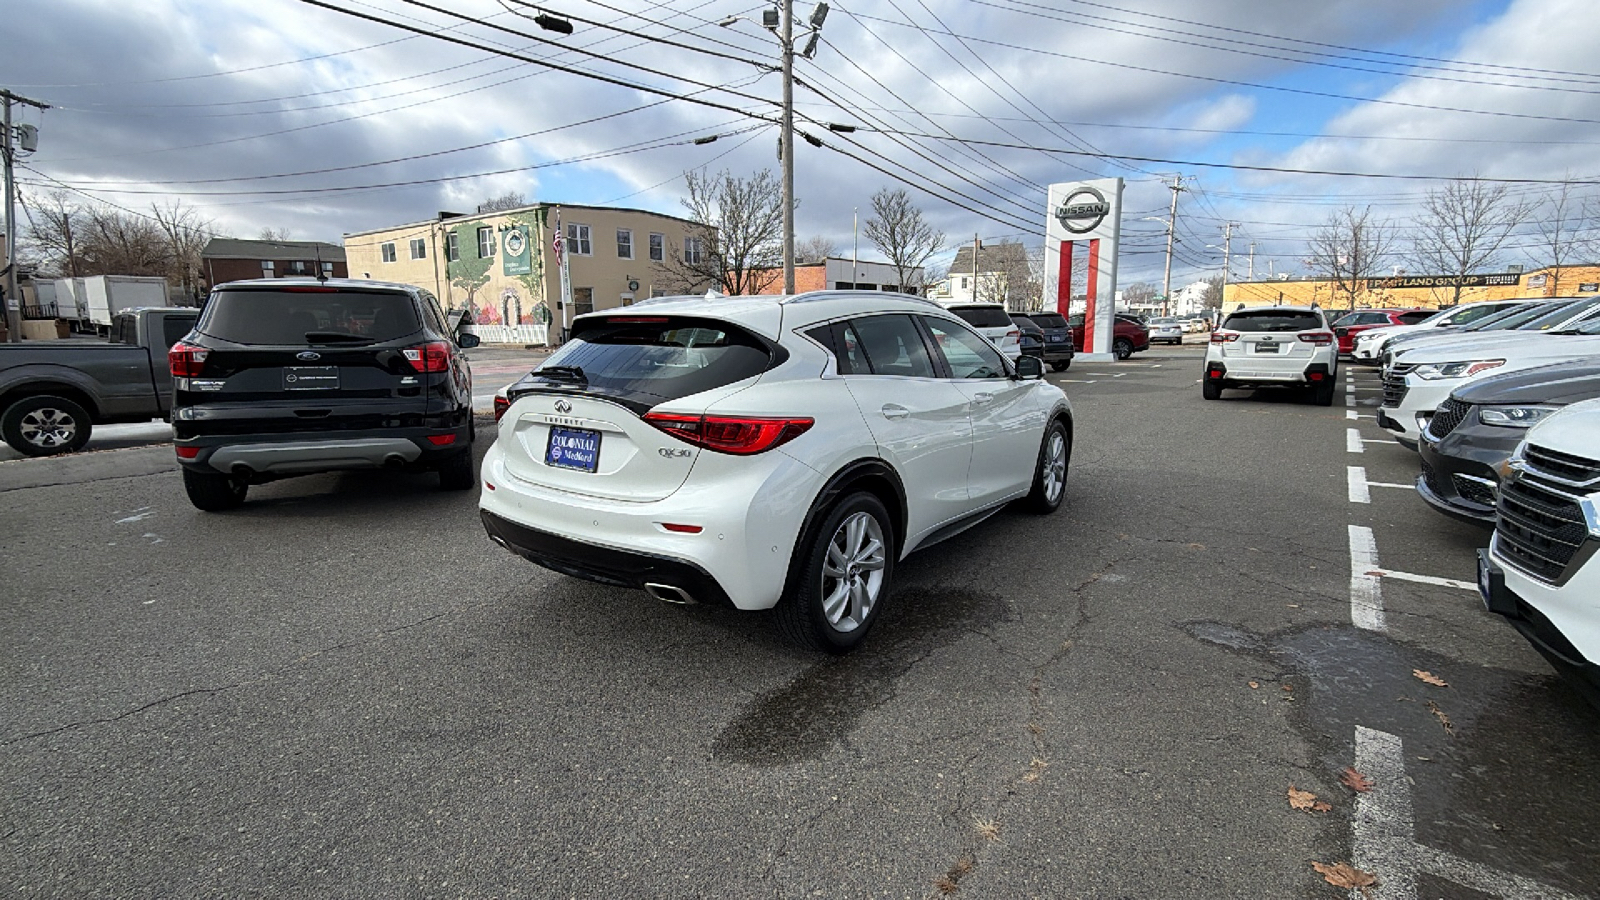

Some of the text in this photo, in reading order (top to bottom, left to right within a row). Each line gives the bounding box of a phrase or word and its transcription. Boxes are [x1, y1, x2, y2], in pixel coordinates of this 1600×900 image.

[1060, 205, 1104, 215] NISSAN
[1374, 278, 1434, 288] PTLAND
[552, 435, 596, 451] COLONIAL
[564, 450, 593, 463] Medford
[658, 448, 691, 459] QX30
